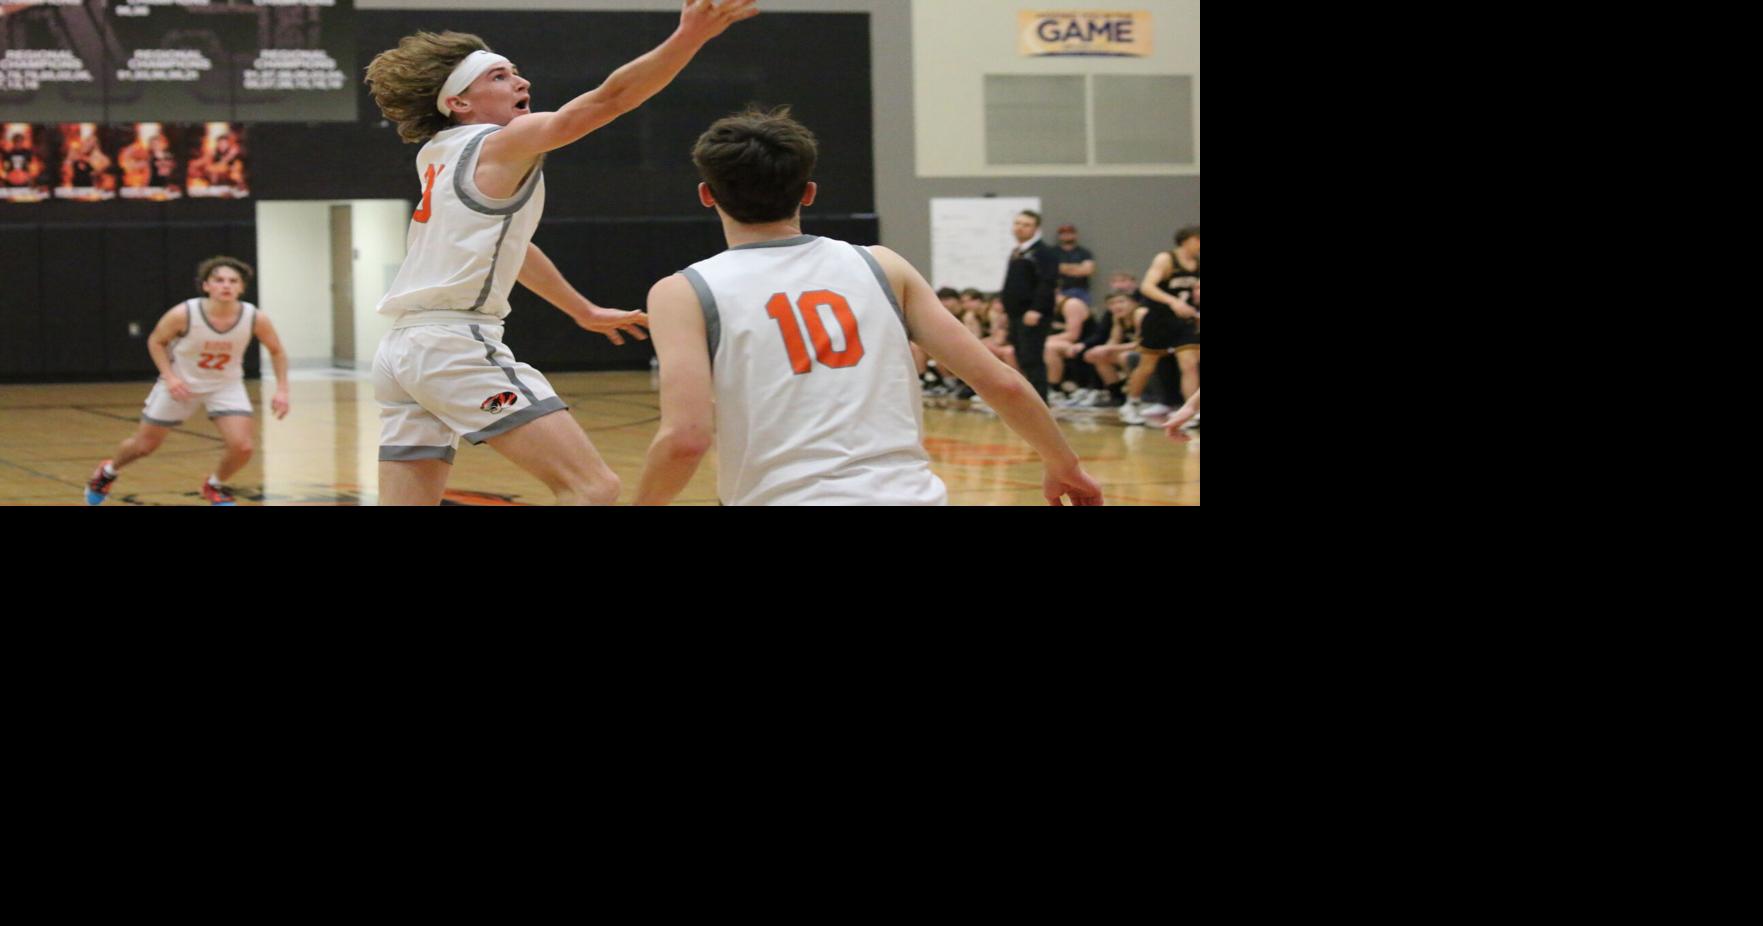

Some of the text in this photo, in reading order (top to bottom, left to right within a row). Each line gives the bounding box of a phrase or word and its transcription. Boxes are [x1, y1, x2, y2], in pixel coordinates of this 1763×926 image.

[1036, 19, 1134, 43] GAME
[0, 58, 83, 70] CHAMPIONS
[127, 58, 212, 70] CHAMPIONS
[253, 58, 337, 70] CHAMPIONS
[764, 289, 865, 375] 10
[197, 352, 231, 371] 22
